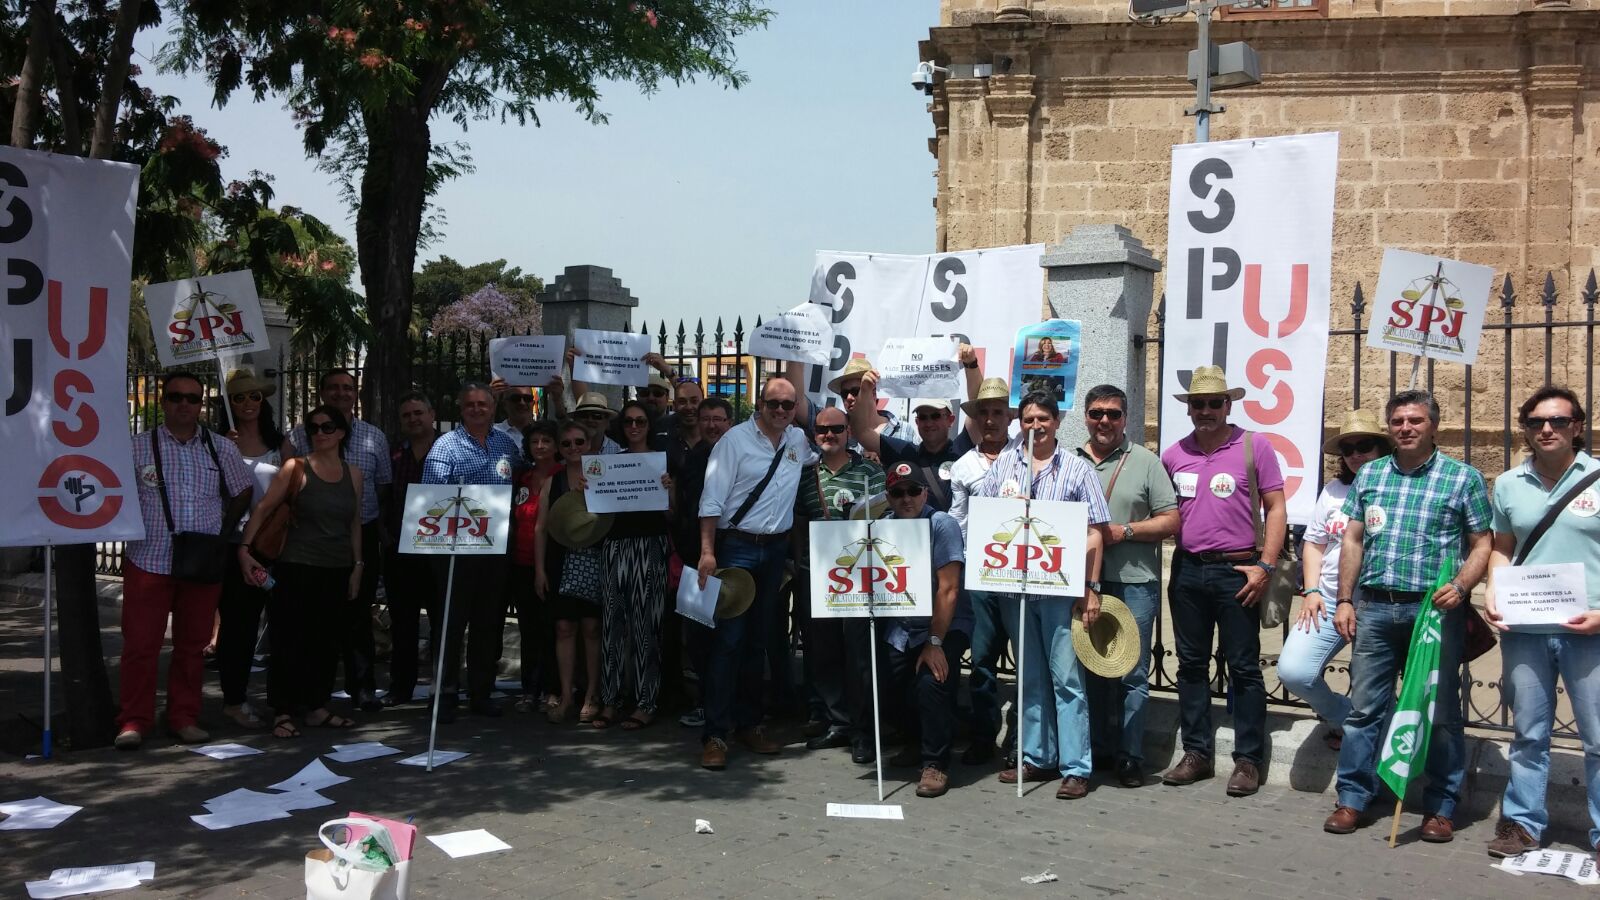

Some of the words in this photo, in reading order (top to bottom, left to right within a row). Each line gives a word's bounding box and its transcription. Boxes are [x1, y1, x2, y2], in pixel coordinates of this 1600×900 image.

[168, 310, 243, 345] SPJ
[1388, 299, 1468, 338] SPJ
[38, 279, 124, 530] USO
[416, 516, 492, 537] SPJ
[982, 542, 1066, 573] SPJ
[828, 566, 911, 594] SPJ
[978, 567, 1005, 578] SINDICATO
[1005, 568, 1039, 580] PROFEONAL
[824, 593, 851, 602] SINDICATO
[852, 592, 886, 602] PROFEONAL
